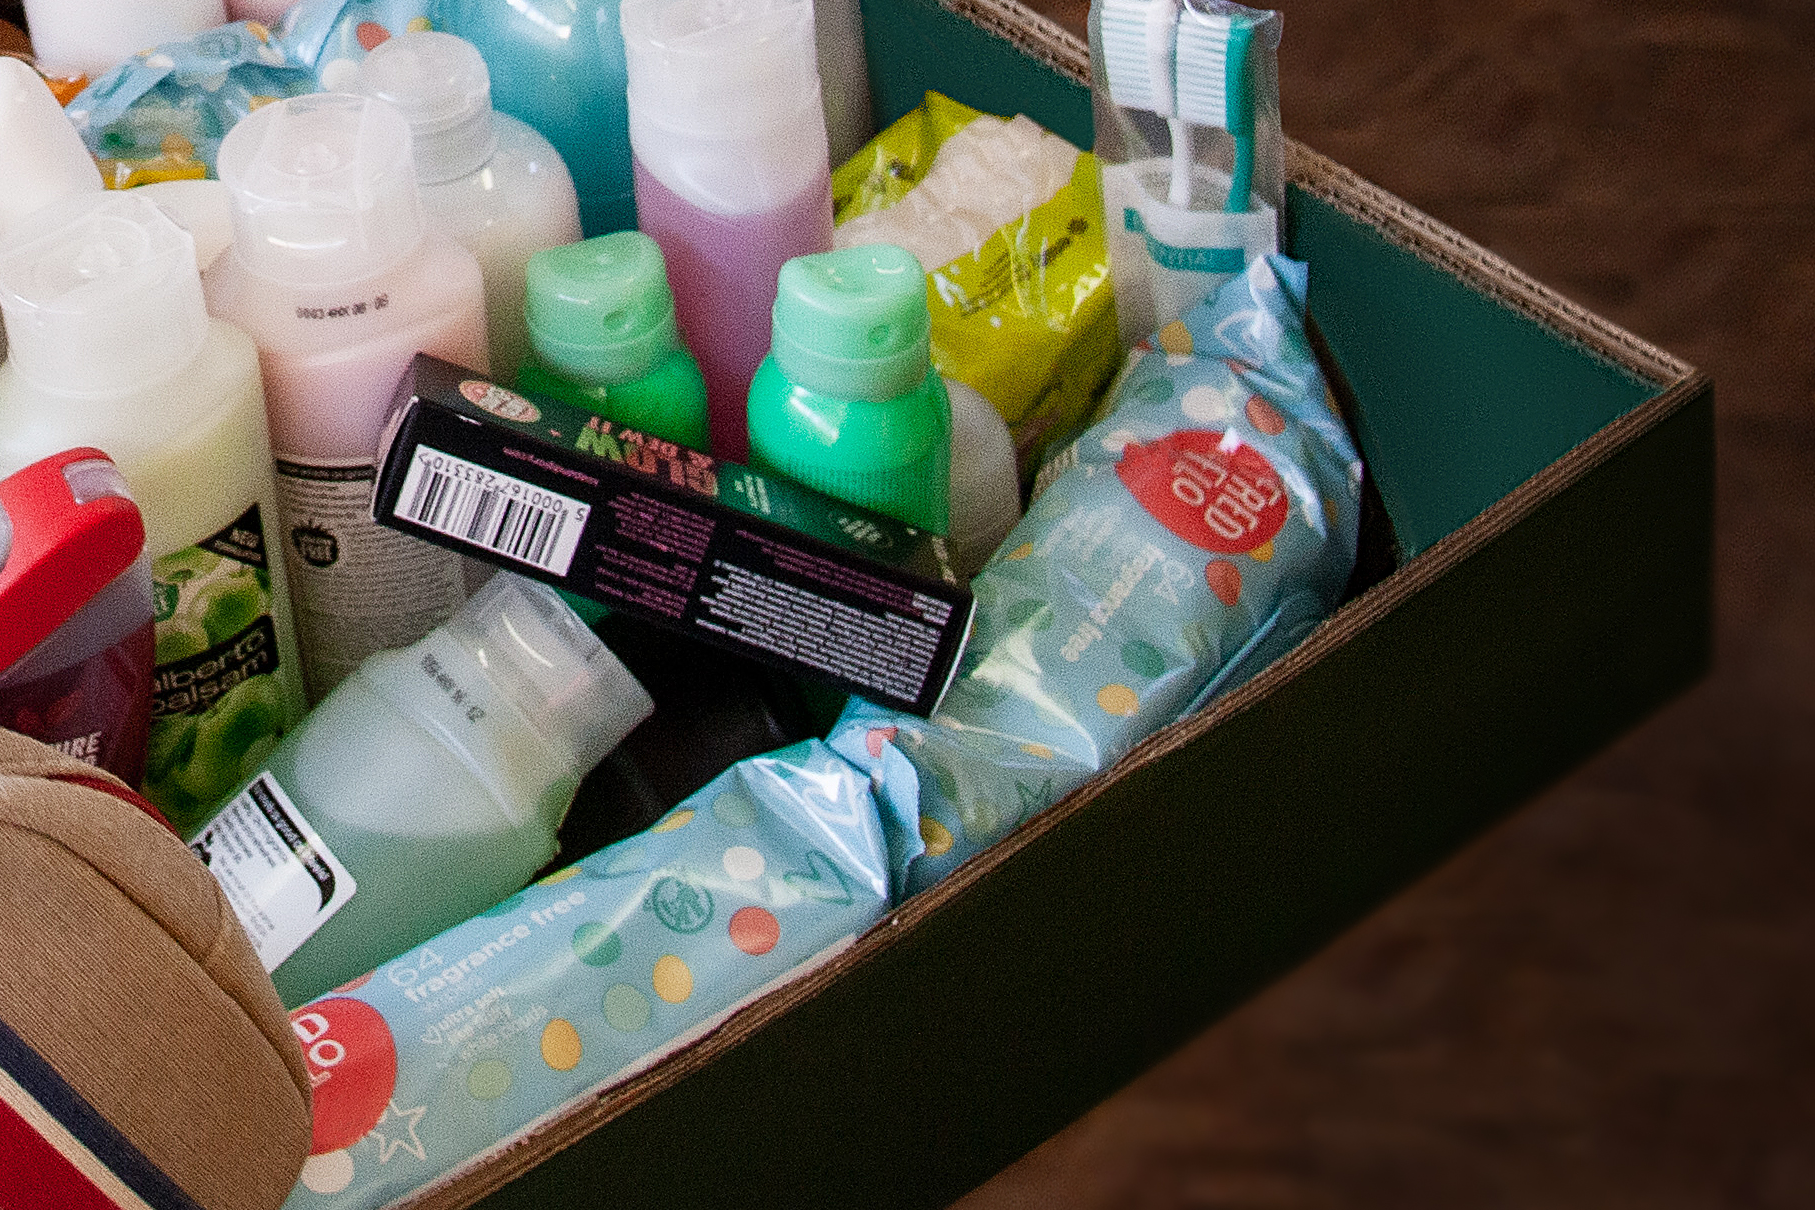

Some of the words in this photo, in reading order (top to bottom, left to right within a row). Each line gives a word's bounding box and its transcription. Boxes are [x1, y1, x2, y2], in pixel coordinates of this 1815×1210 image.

[574, 424, 718, 496] GLOW
[1173, 452, 1228, 508] FLO
[577, 508, 584, 521] 5
[1204, 472, 1281, 541] FRED
[1091, 541, 1167, 625] fragrance
[1060, 623, 1102, 661] free
[388, 948, 443, 987] 64
[405, 925, 530, 1001] fragrance
[531, 890, 588, 928] free
